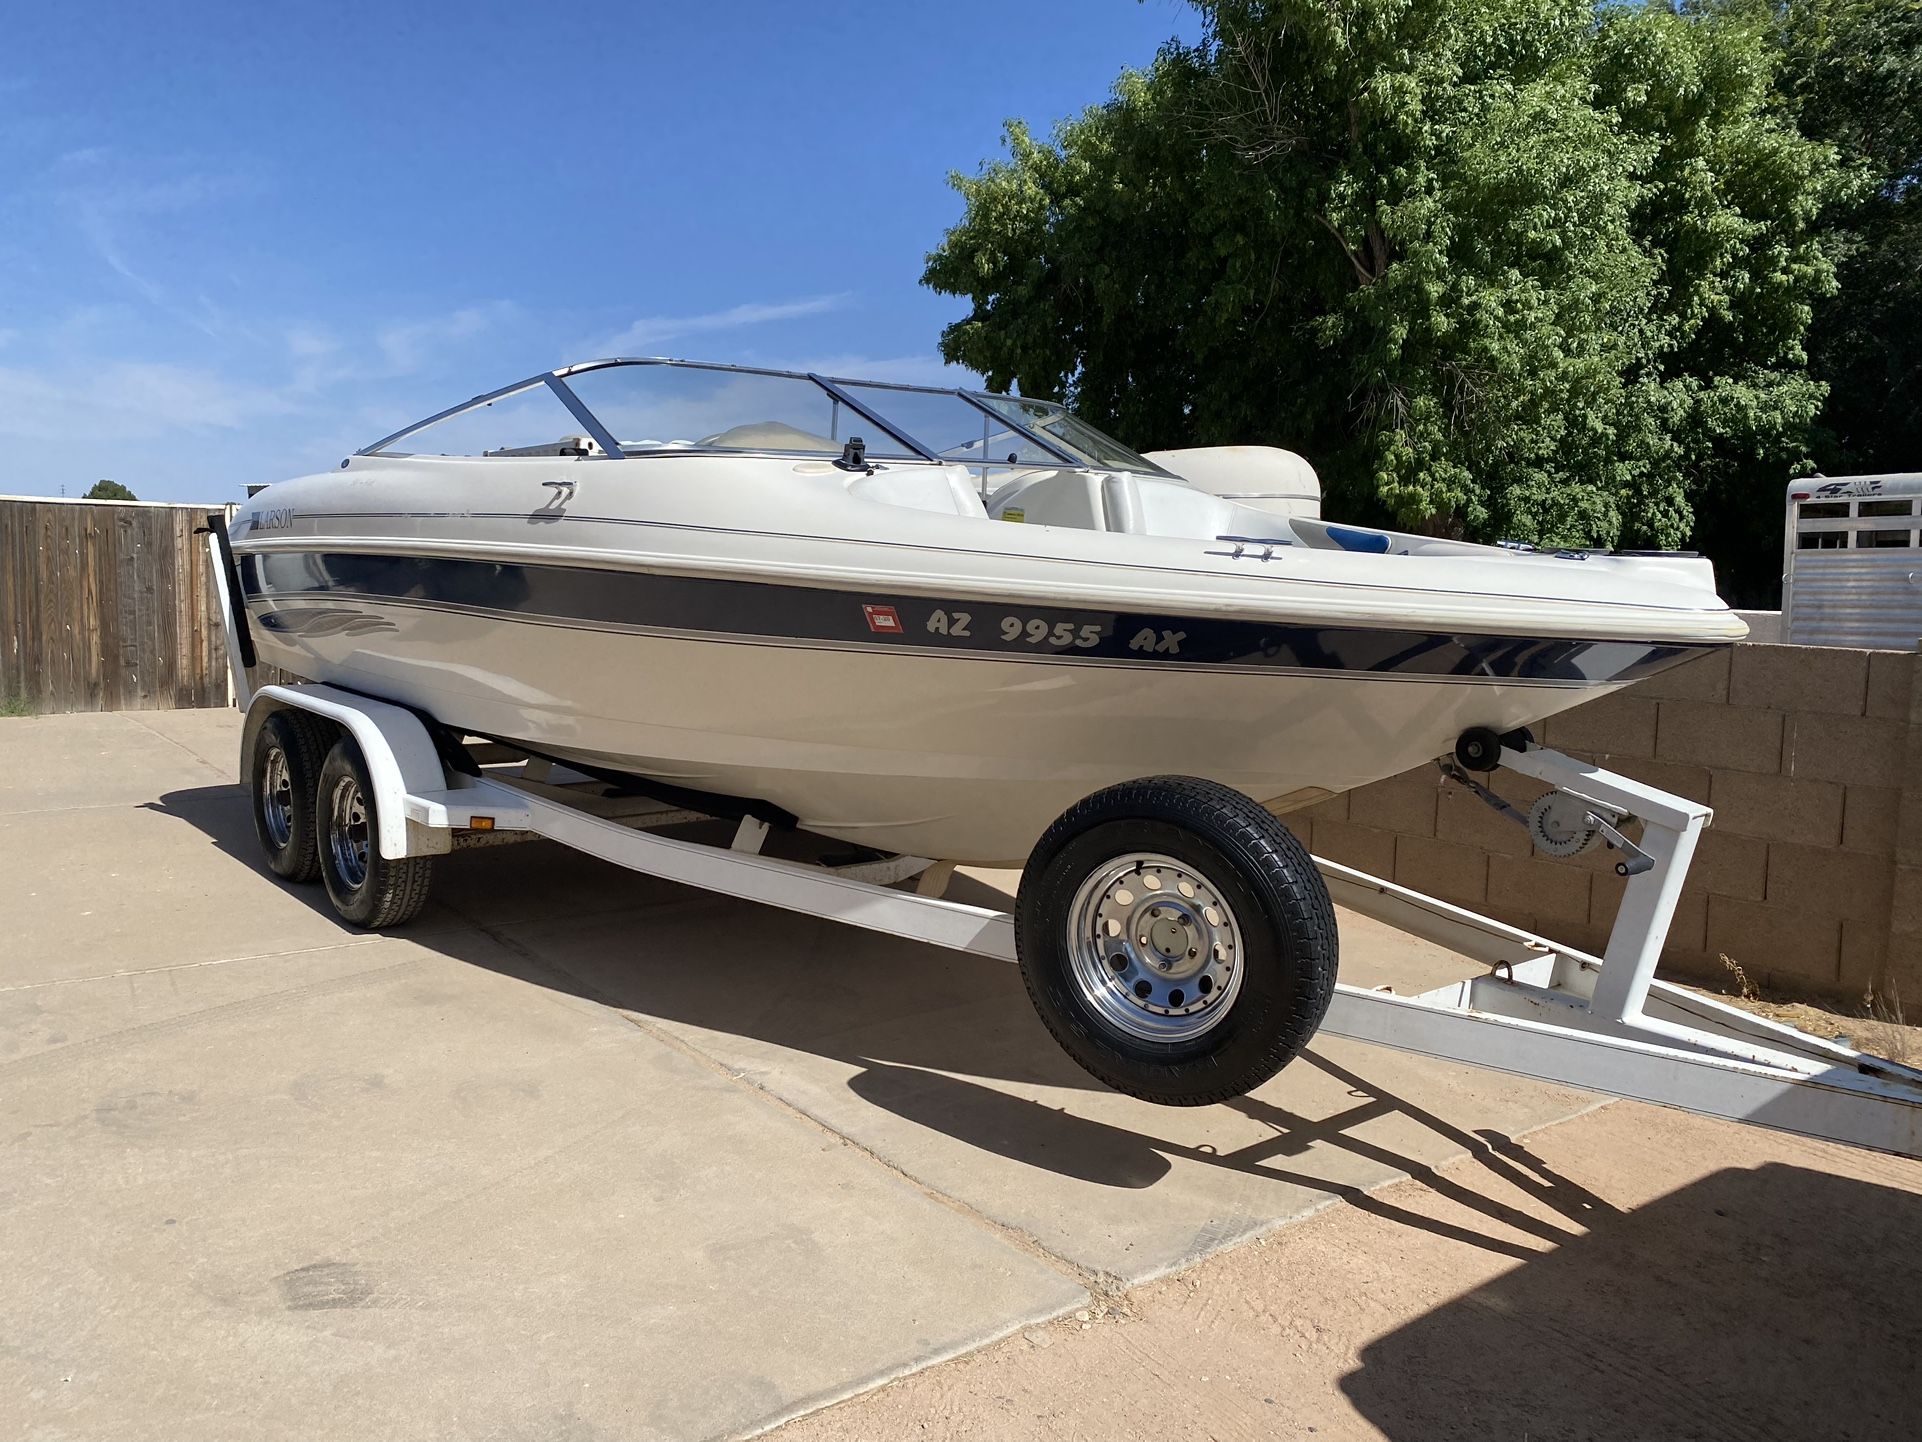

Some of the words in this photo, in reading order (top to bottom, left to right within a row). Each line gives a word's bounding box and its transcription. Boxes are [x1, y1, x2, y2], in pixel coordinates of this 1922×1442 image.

[259, 508, 295, 530] LARSON
[926, 609, 972, 637] AZ
[1000, 616, 1102, 648] 9955
[1129, 628, 1187, 654] AX
